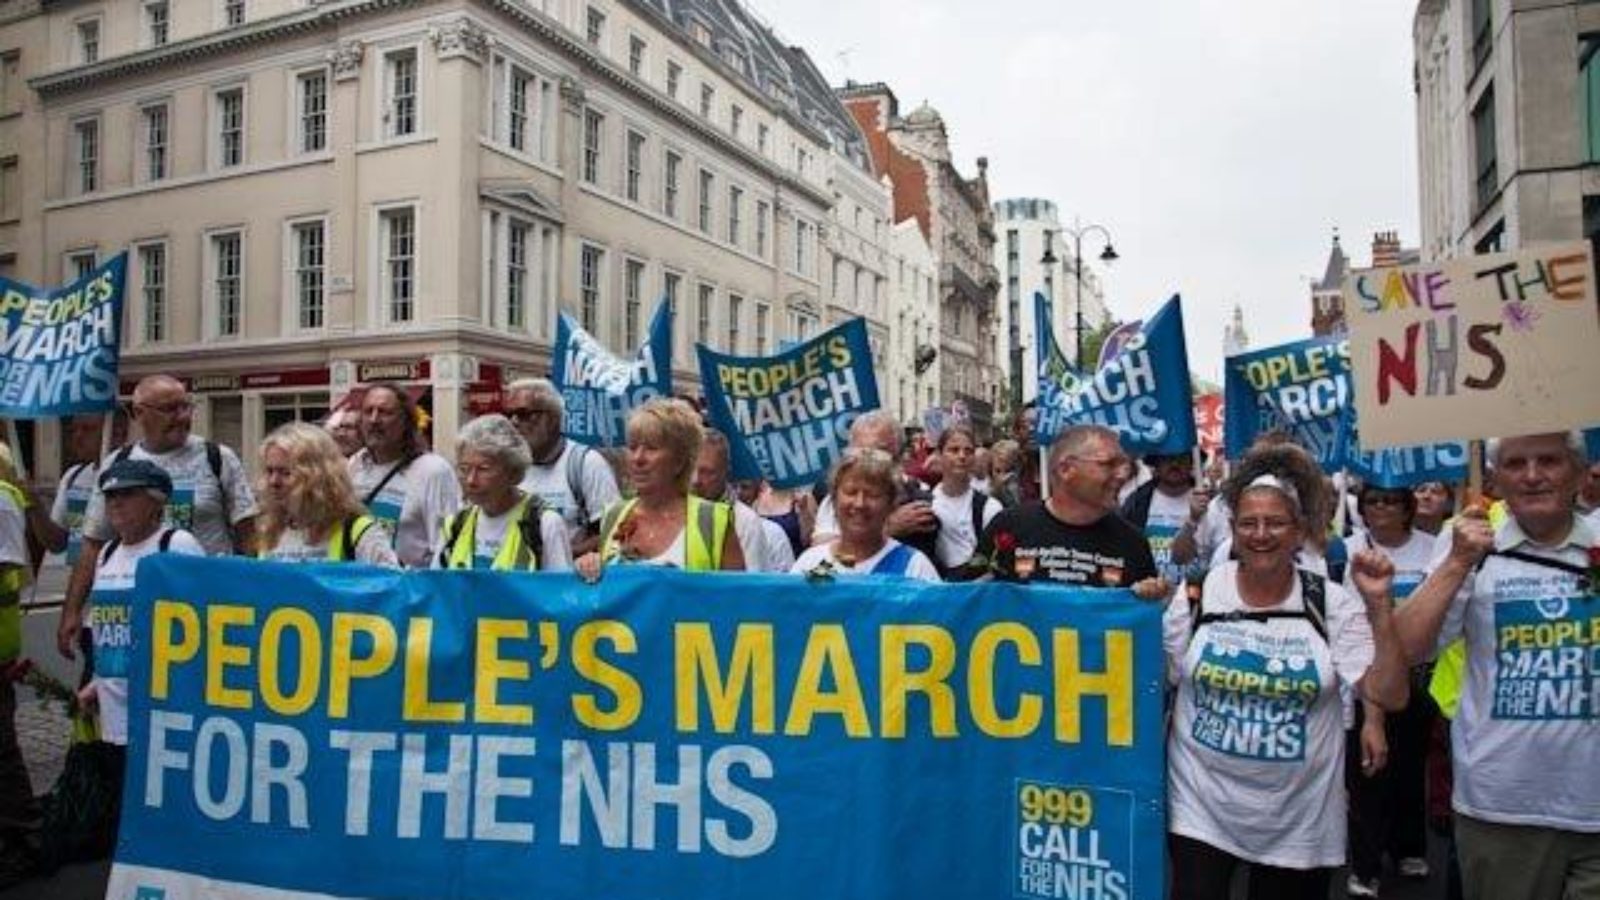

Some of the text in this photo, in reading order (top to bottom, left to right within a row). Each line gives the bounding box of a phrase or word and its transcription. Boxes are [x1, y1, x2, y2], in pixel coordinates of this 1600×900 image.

[1355, 254, 1589, 313] SAVE THE
[20, 346, 118, 406] NHS
[717, 334, 851, 398] PEOPLE'S
[1240, 340, 1351, 391] OPLE'S
[1376, 314, 1508, 406] NHS
[149, 599, 1135, 746] PEOPLE'S MARCH
[1196, 661, 1317, 698] PEOPLE'S
[1500, 679, 1536, 697] FOR
[1497, 678, 1600, 717] THE NH
[1220, 716, 1302, 759] NHS
[144, 708, 779, 858] FOR THE NHS
[1019, 784, 1093, 827] 999
[1018, 821, 1111, 869] CALL
[1021, 858, 1054, 878] FOR
[1020, 861, 1129, 900] THE NHS
